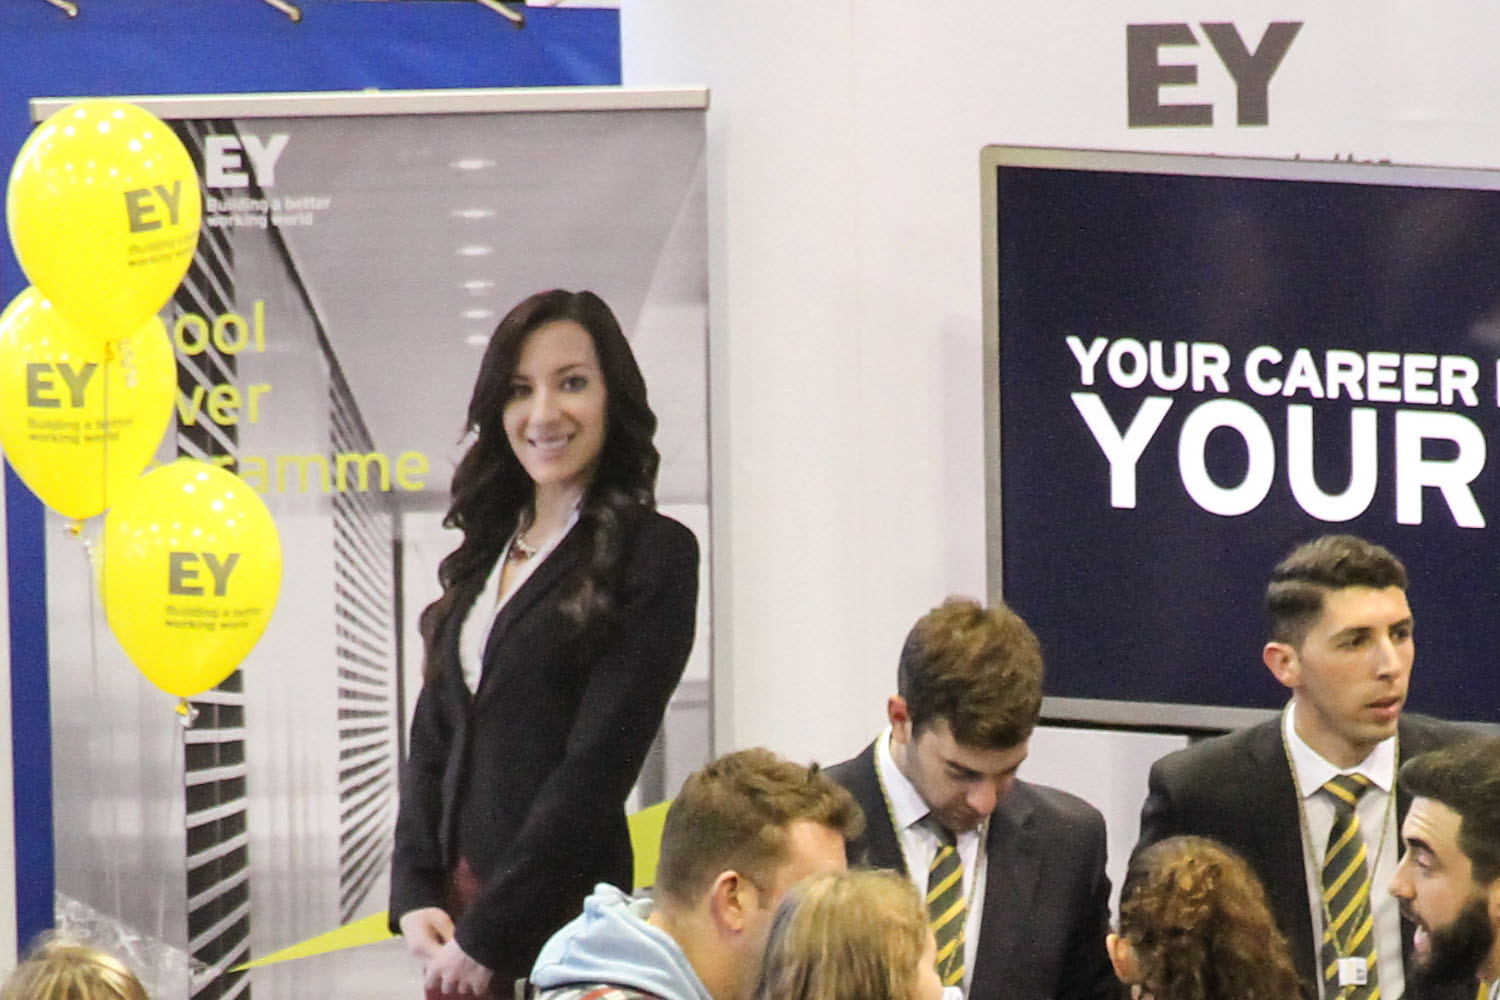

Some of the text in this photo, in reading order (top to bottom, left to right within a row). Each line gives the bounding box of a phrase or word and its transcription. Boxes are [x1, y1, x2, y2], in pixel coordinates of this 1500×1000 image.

[1126, 21, 1304, 128] EY
[205, 134, 290, 189] EY
[124, 179, 182, 234] EY
[174, 301, 265, 356] ool
[27, 363, 98, 408] EY
[1065, 335, 1231, 393] YOUR
[1244, 345, 1480, 407] CAREER
[175, 383, 272, 426] ver
[1071, 392, 1487, 529] YOUR
[168, 551, 241, 597] EY
